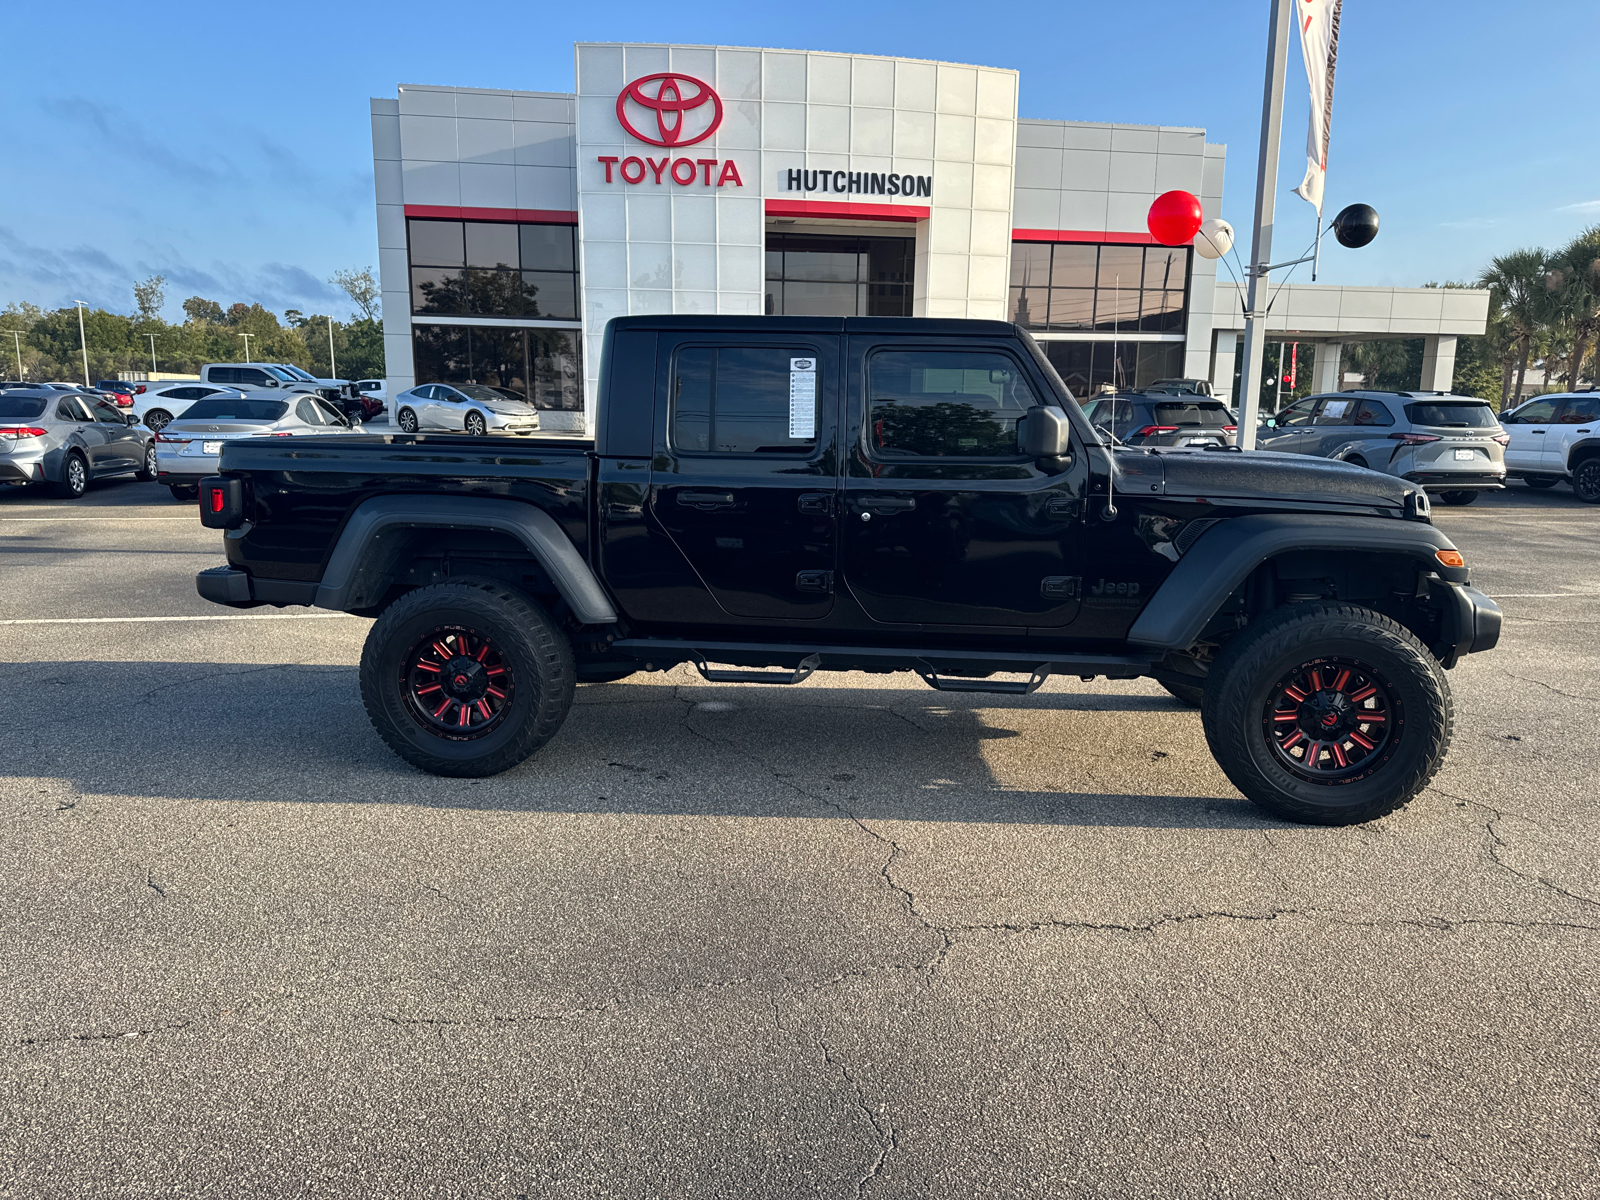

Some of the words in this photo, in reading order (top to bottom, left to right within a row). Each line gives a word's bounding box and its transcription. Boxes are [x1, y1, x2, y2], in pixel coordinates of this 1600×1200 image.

[597, 155, 743, 187] TOYOTA
[787, 168, 932, 197] HUTCHINSON
[1091, 578, 1140, 597] Jeep
[1301, 658, 1328, 669] FUEL
